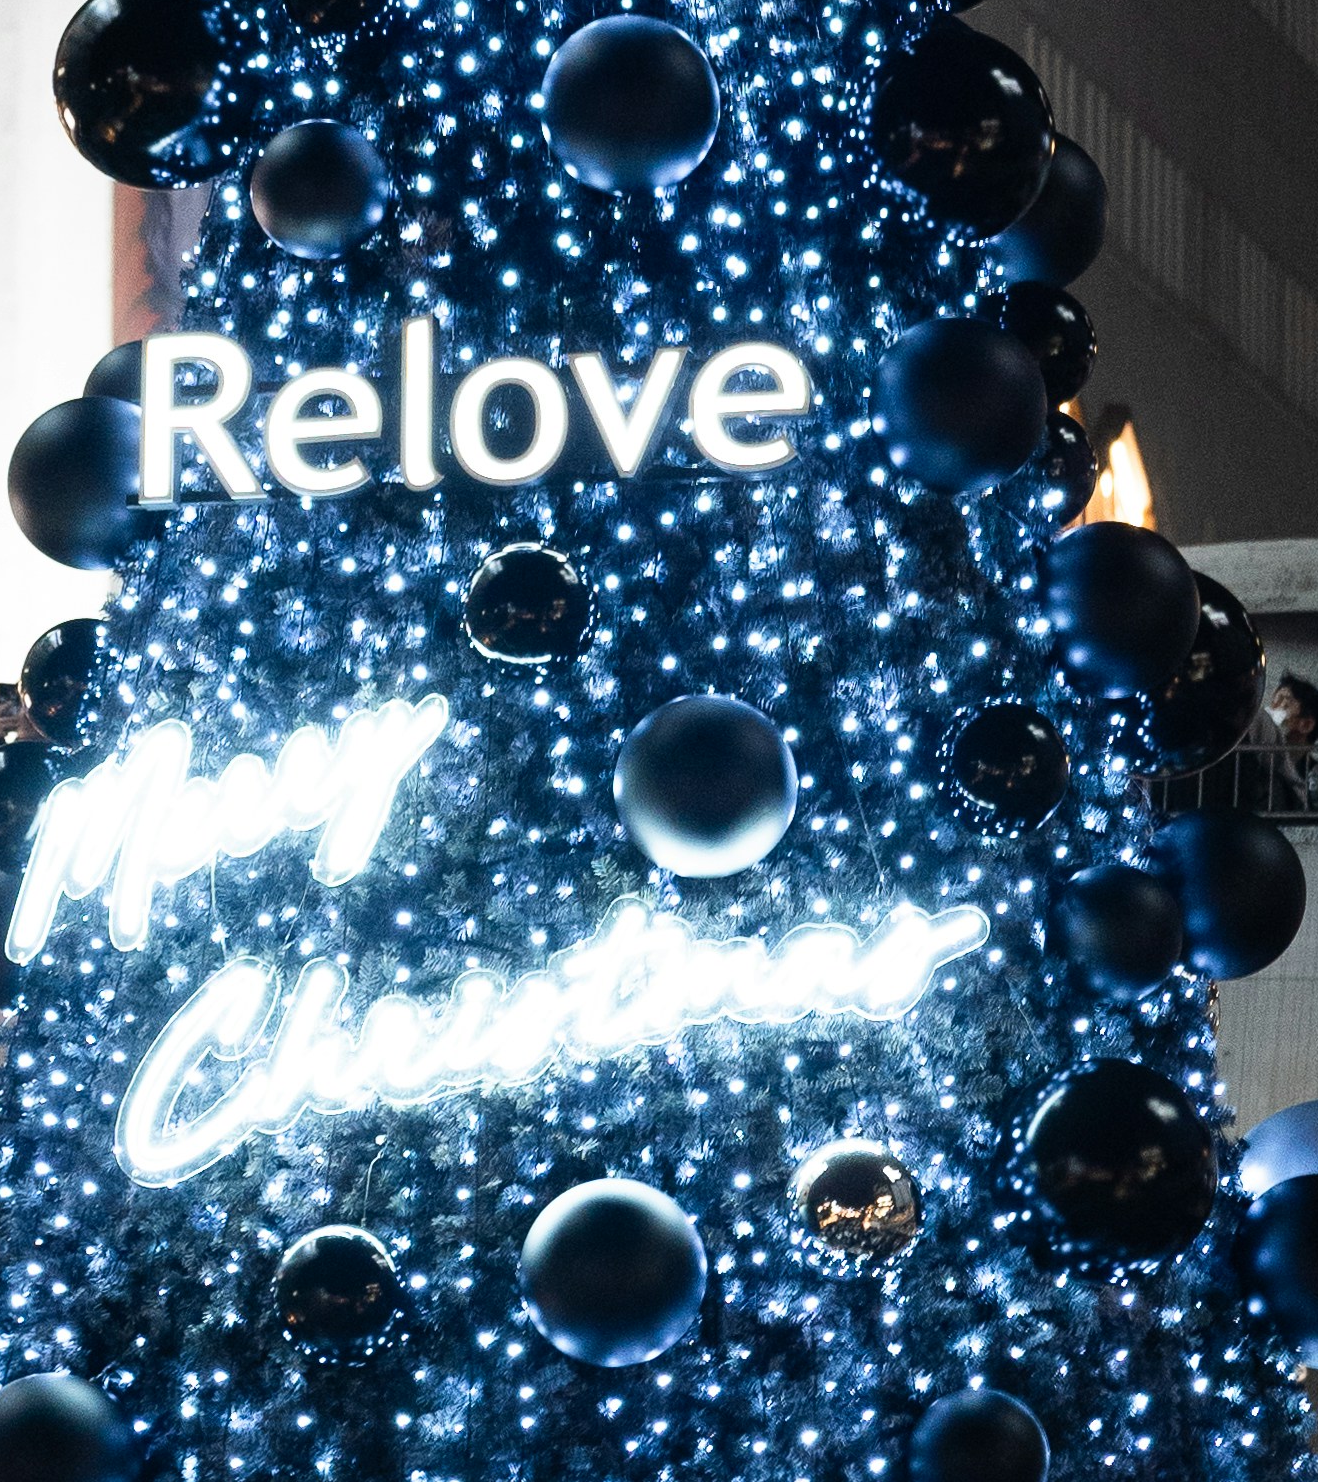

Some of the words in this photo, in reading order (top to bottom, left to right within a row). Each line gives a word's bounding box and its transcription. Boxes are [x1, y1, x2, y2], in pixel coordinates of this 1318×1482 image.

[138, 317, 812, 505] Relove
[7, 695, 448, 961] Merry
[118, 897, 986, 1186] Christmas
